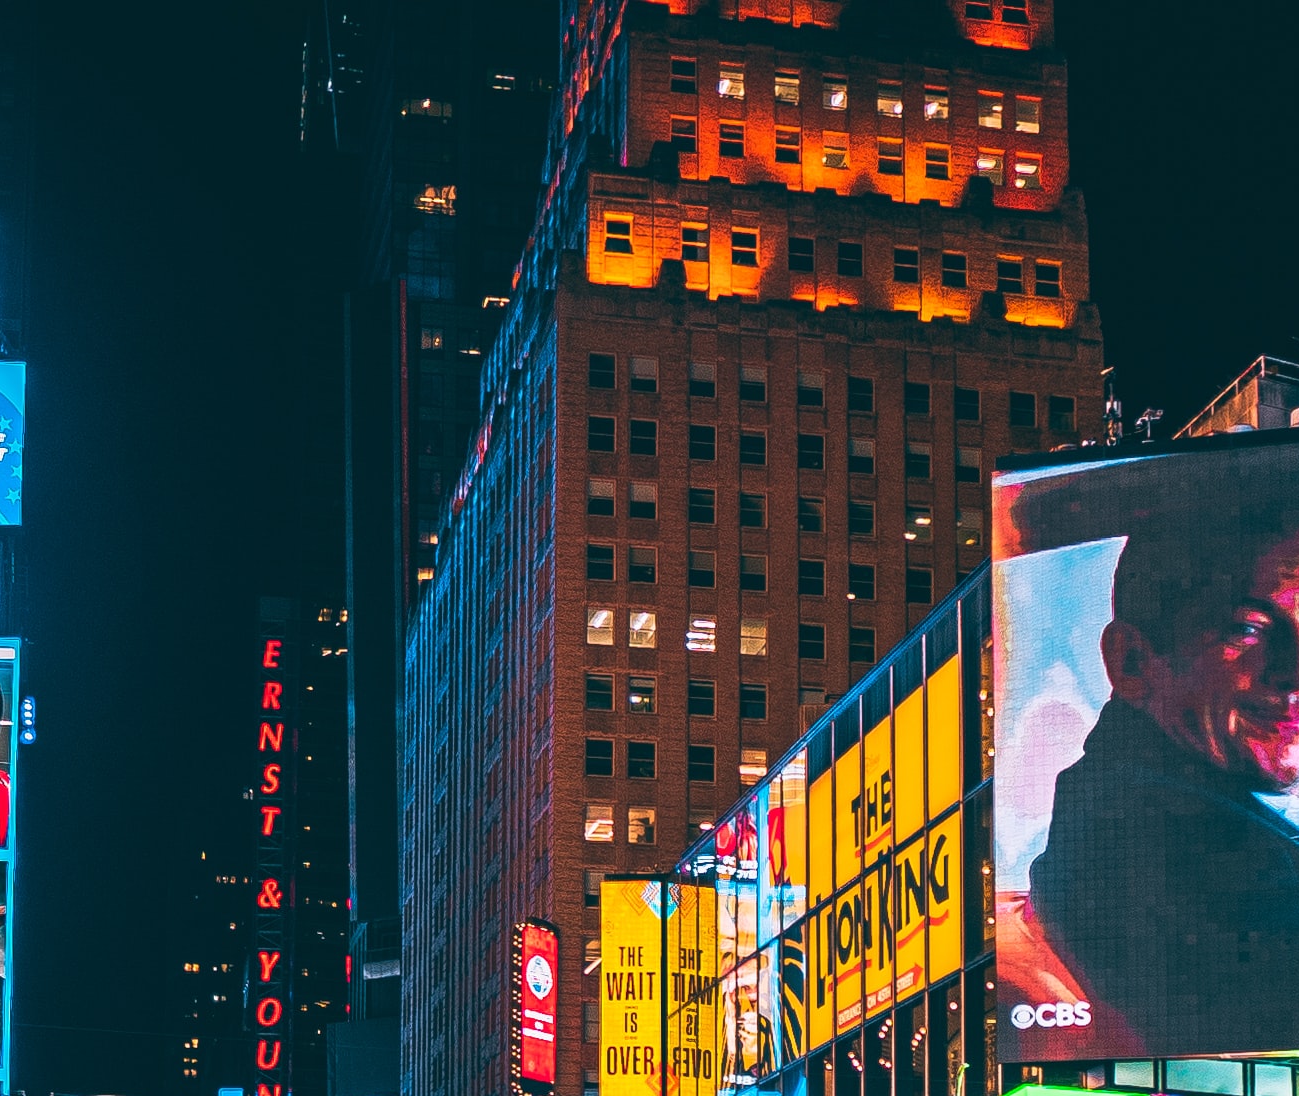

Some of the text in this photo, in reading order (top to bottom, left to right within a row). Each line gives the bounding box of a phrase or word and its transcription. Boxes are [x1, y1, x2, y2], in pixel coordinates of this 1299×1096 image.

[258, 639, 284, 836] ERNST
[851, 770, 892, 848] THE
[815, 834, 949, 1009] LION KING
[619, 947, 643, 966] THE
[607, 973, 655, 1001] WAIT
[624, 1012, 637, 1032] IS
[1036, 1001, 1092, 1028] CBS
[607, 1047, 654, 1075] OVER
